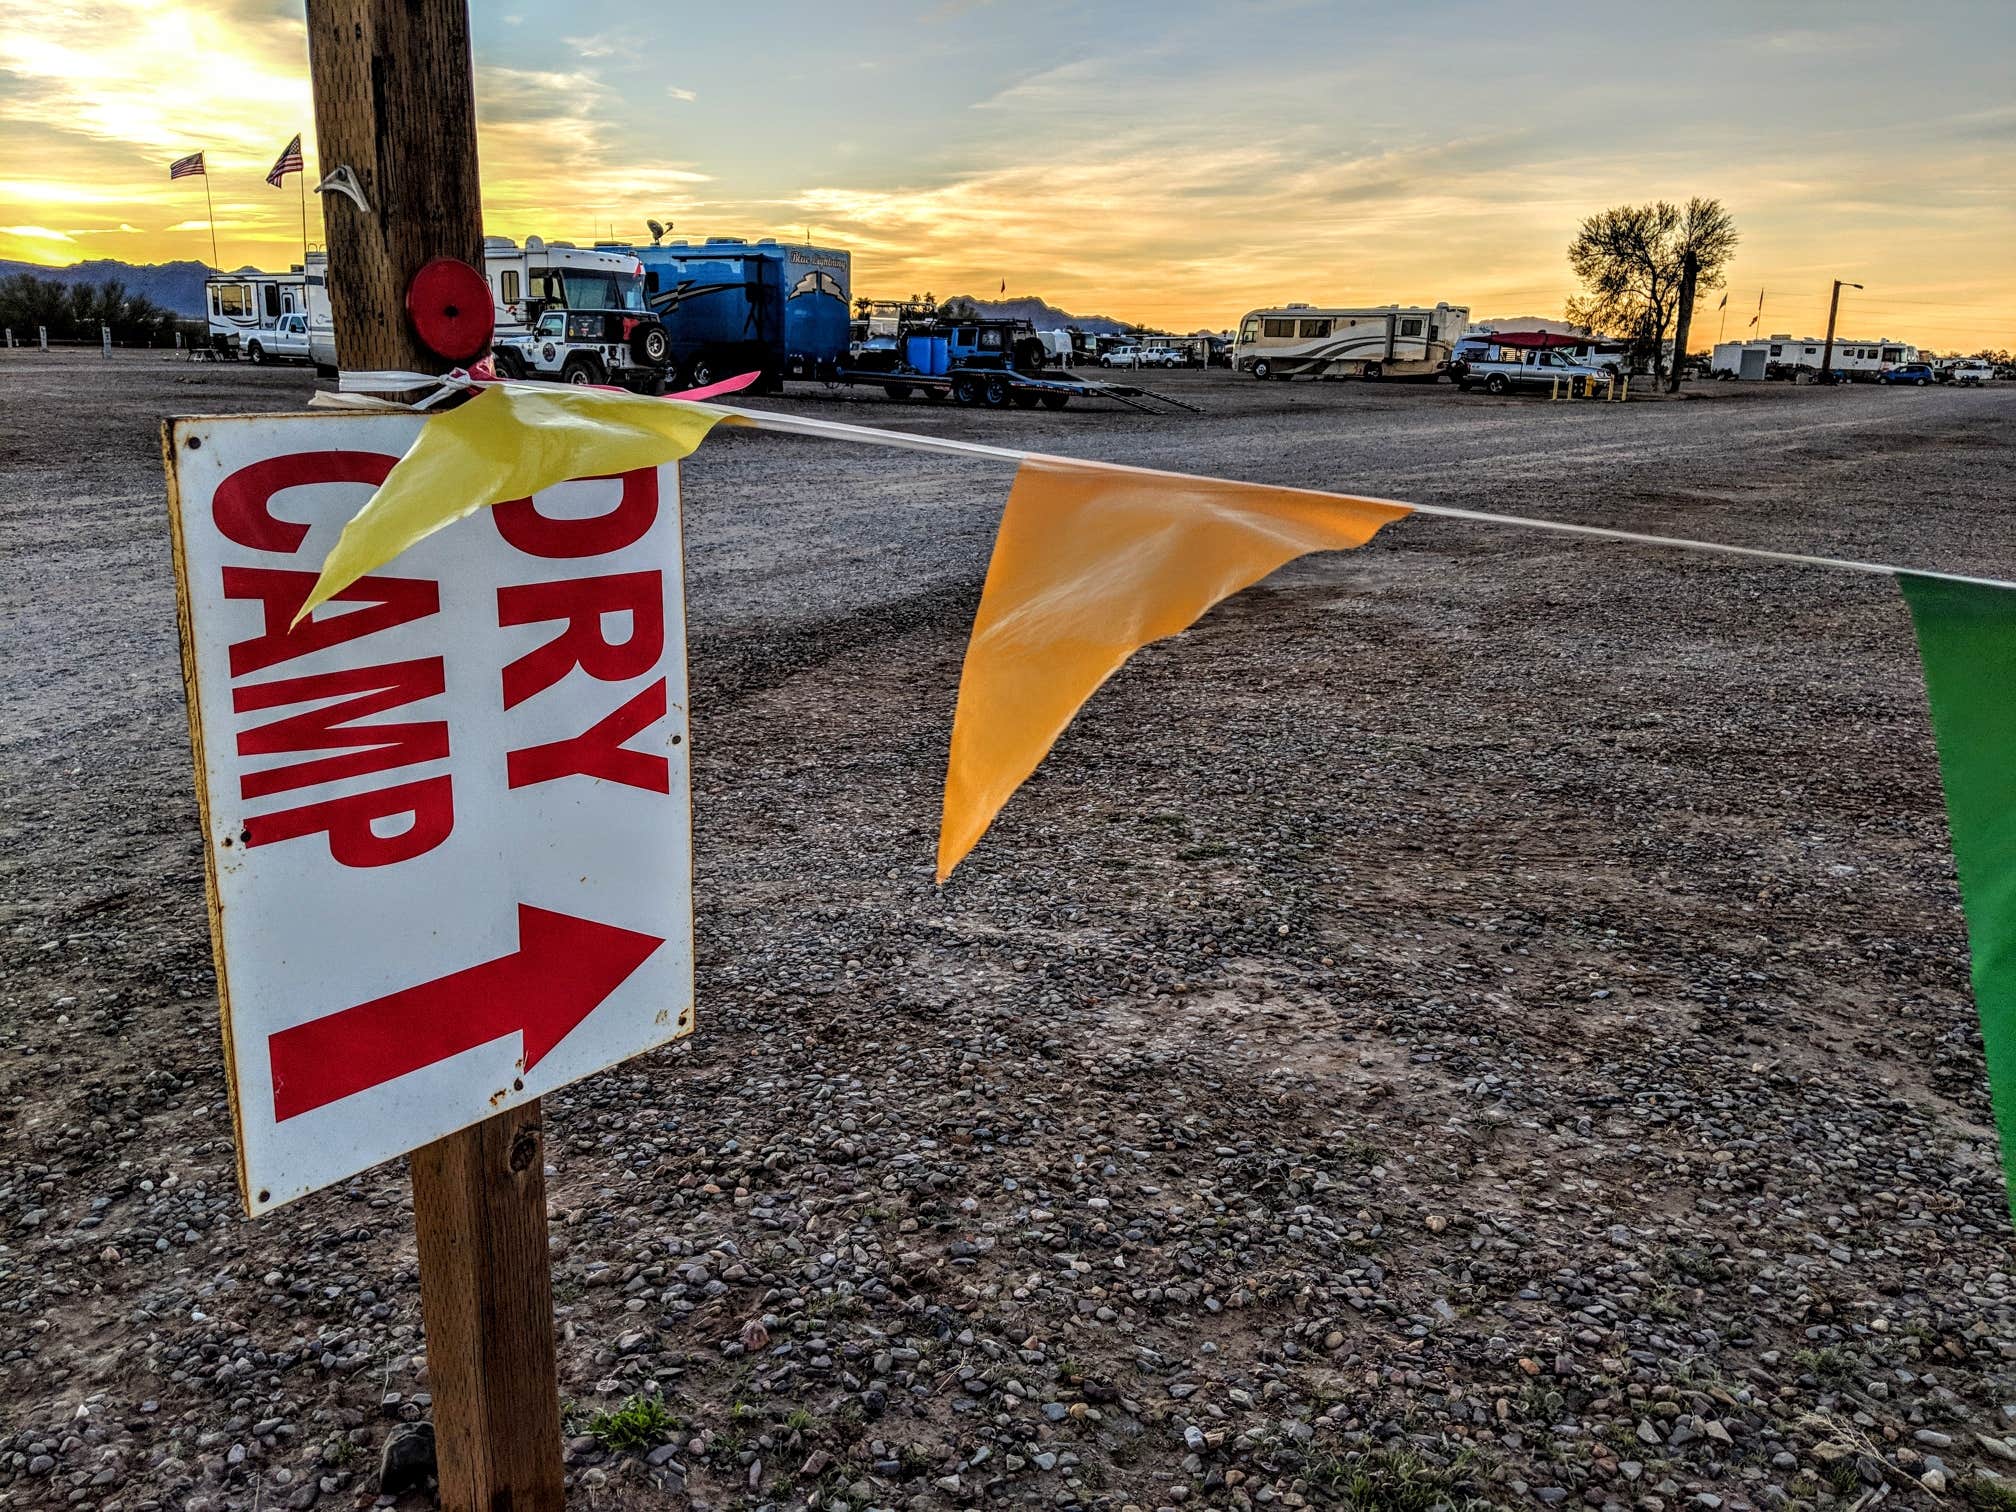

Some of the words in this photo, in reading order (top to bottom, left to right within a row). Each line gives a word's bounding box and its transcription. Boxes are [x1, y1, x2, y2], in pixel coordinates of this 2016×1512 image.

[791, 250, 810, 264] Blue
[212, 450, 456, 869] CAMP
[491, 465, 671, 796] DRY
